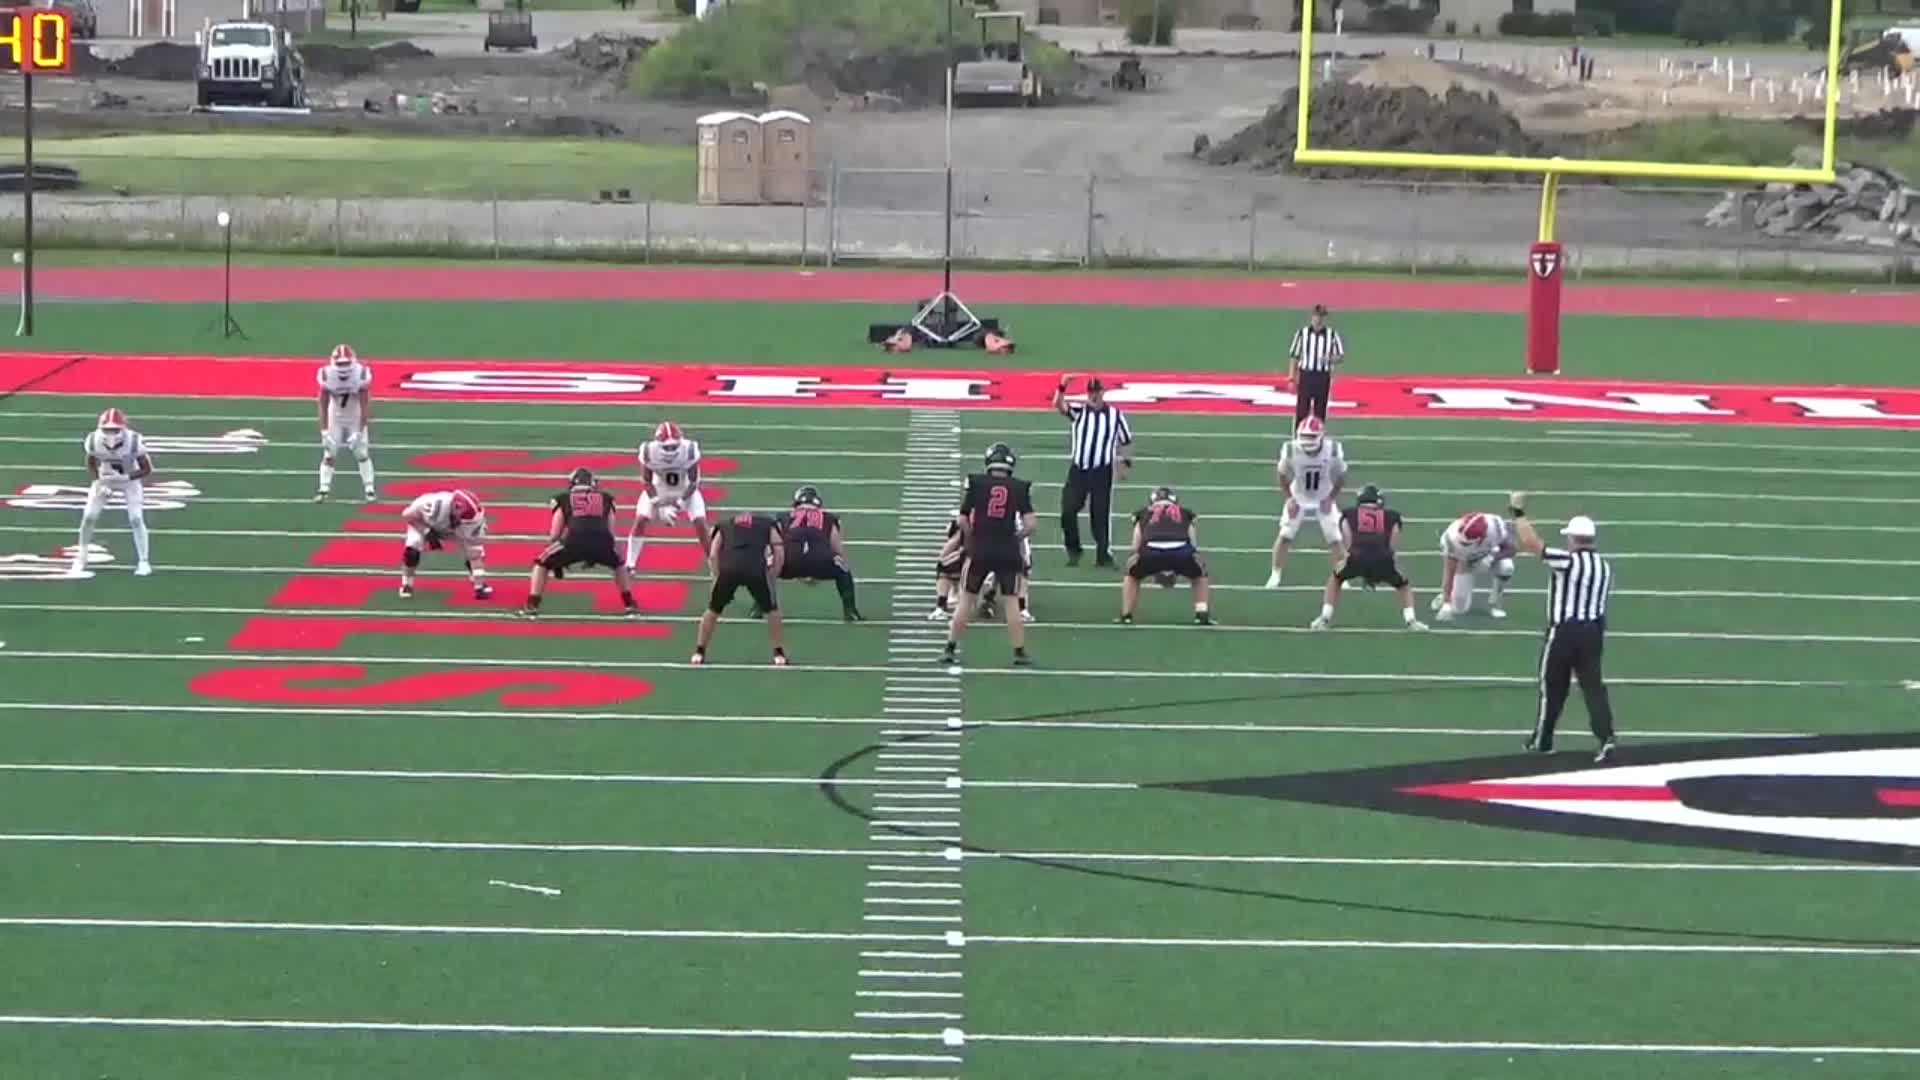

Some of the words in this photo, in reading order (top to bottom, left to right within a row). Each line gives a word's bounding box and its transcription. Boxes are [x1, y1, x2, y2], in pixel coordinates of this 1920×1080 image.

[665, 472, 680, 488] 0
[1305, 471, 1320, 491] 11
[986, 485, 1008, 518] 2
